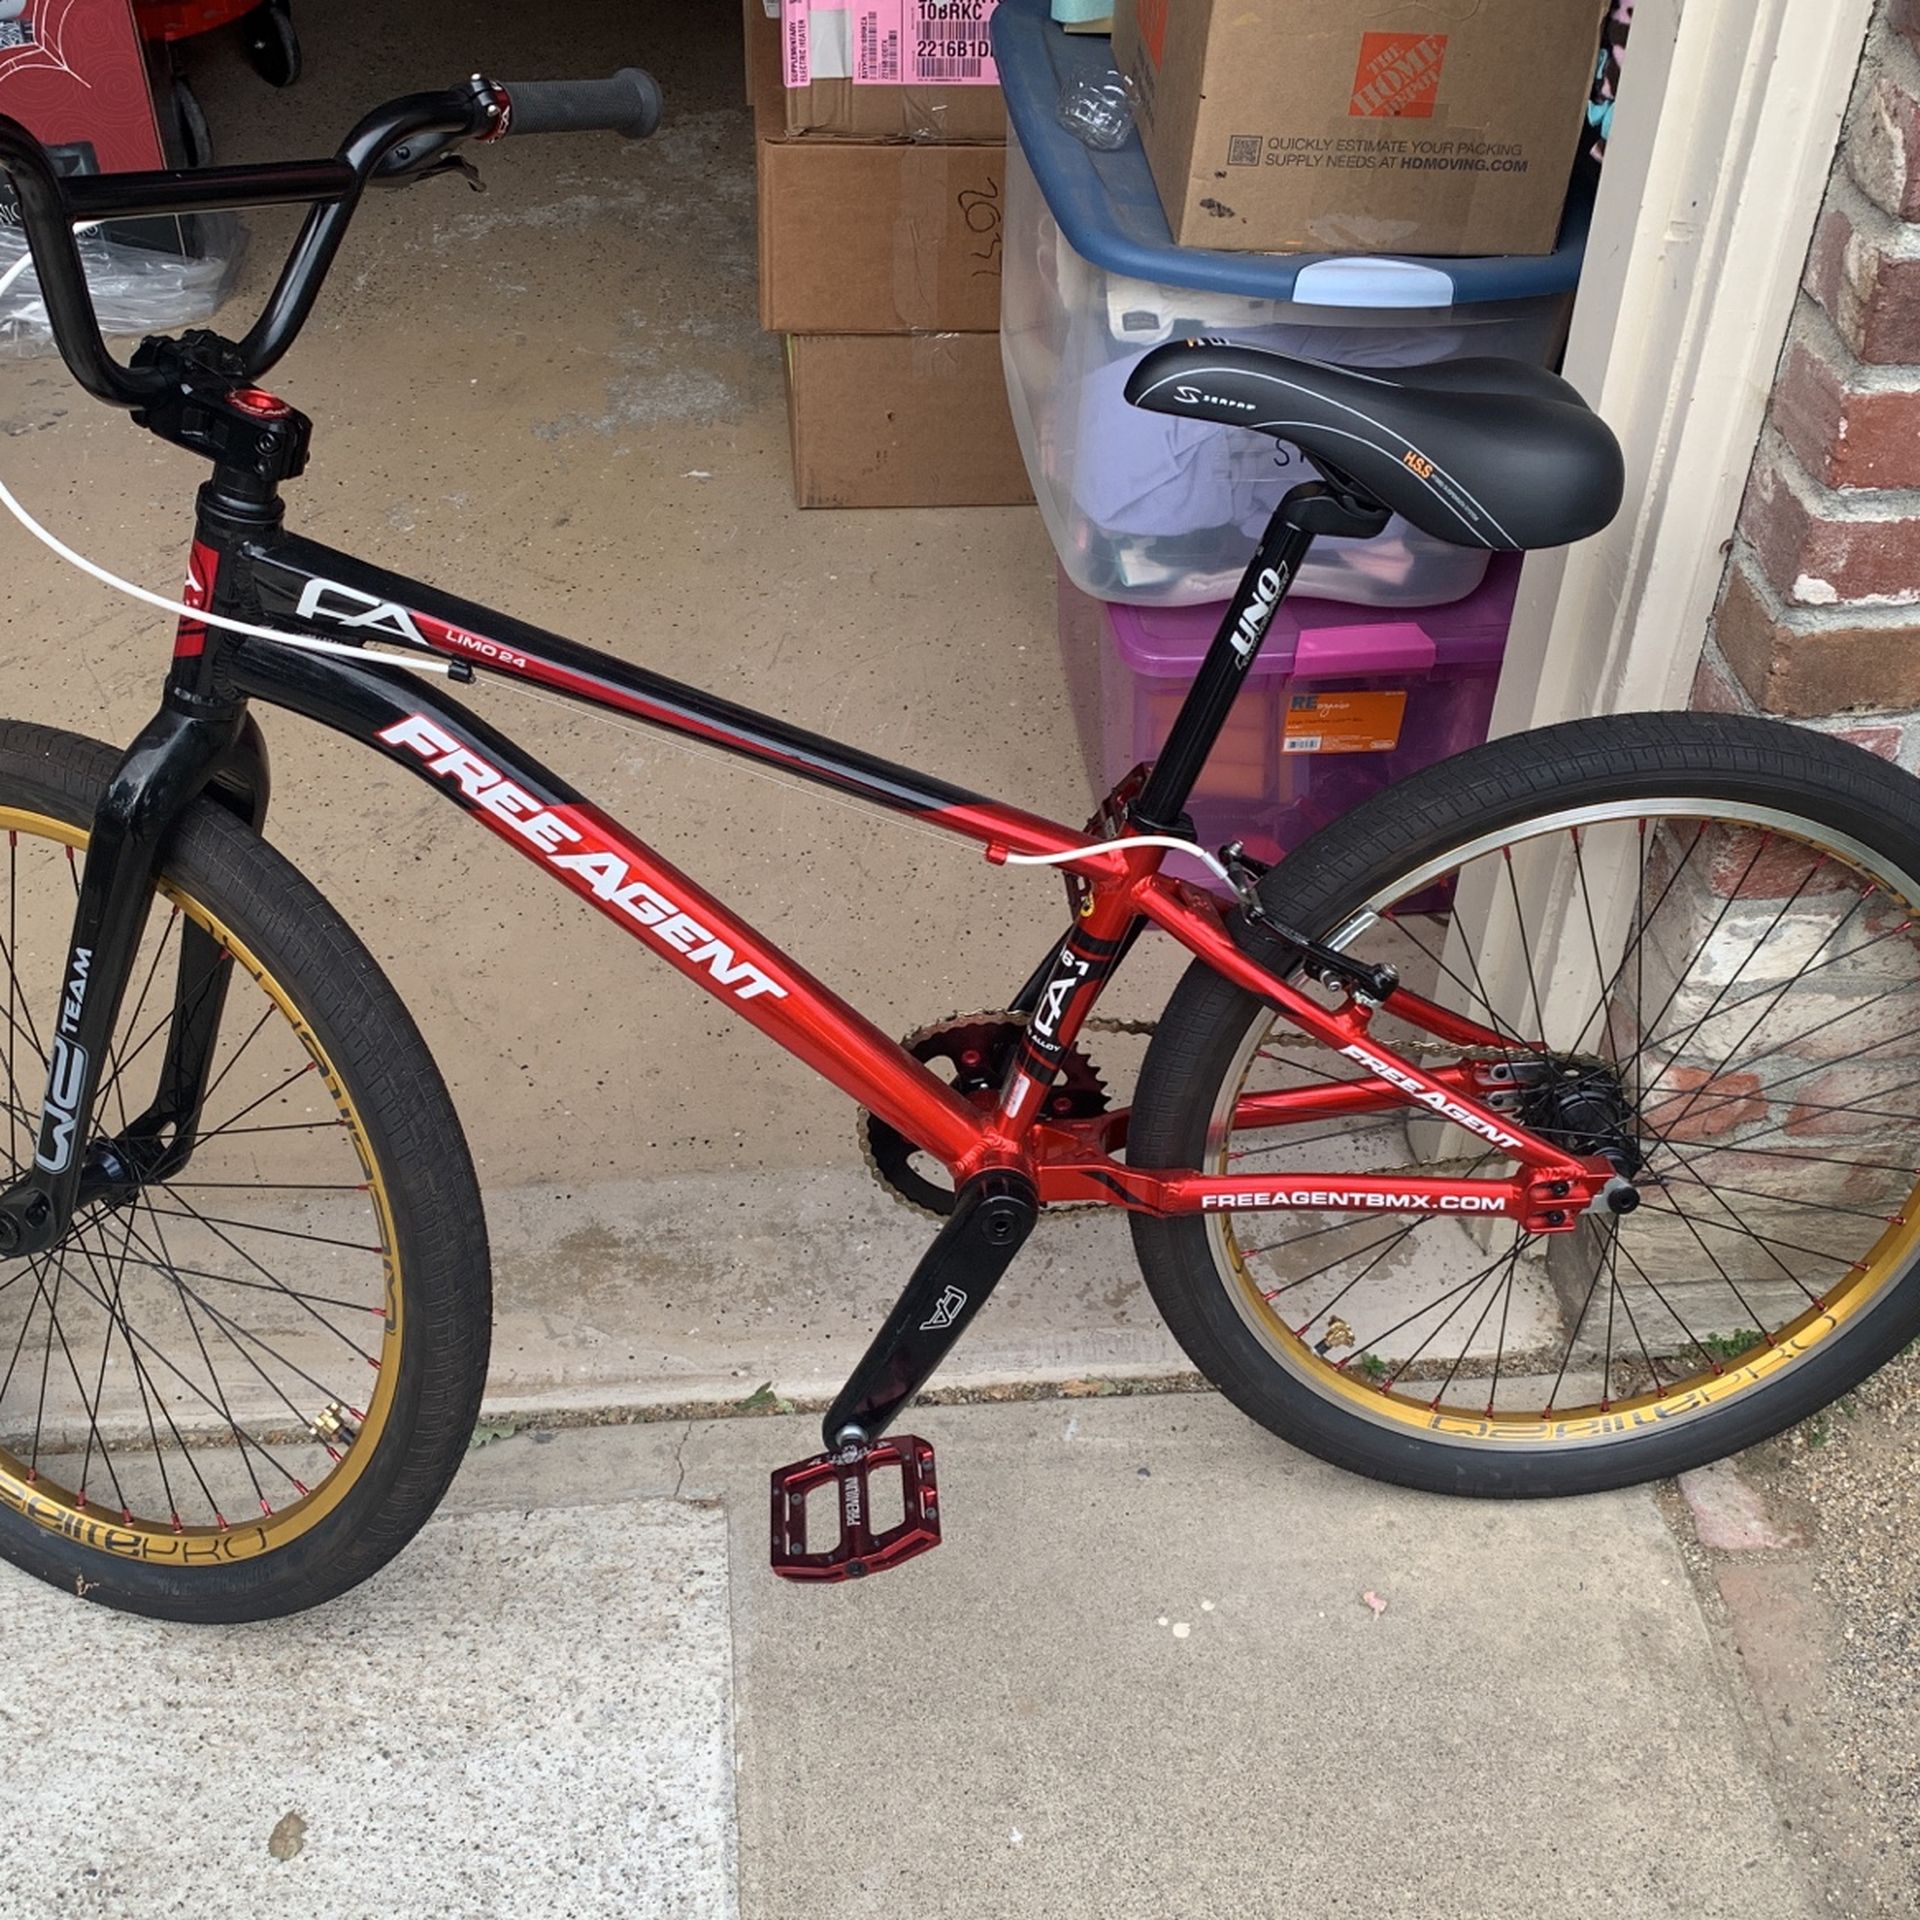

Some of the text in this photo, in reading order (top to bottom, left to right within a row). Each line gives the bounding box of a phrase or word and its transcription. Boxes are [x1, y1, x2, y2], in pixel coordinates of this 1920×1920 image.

[797, 19, 808, 82] ELECTRIC HEATER
[1366, 44, 1400, 74] THE
[1353, 36, 1444, 115] HOME
[1384, 66, 1439, 115] DEPOT
[1264, 152, 1529, 173] SUPPLY NEEDS AT HDMOVING.COM
[1267, 136, 1524, 157] QUICKLY ESTIMATE YOUR PACKING
[1230, 567, 1281, 656] UNO
[446, 630, 527, 669] LIMO 24
[1061, 944, 1089, 976] 61
[61, 947, 93, 1034] TEAM
[1201, 1192, 1506, 1211] FREEAGENTBMX.COM
[845, 1476, 861, 1527] PREMIUM
